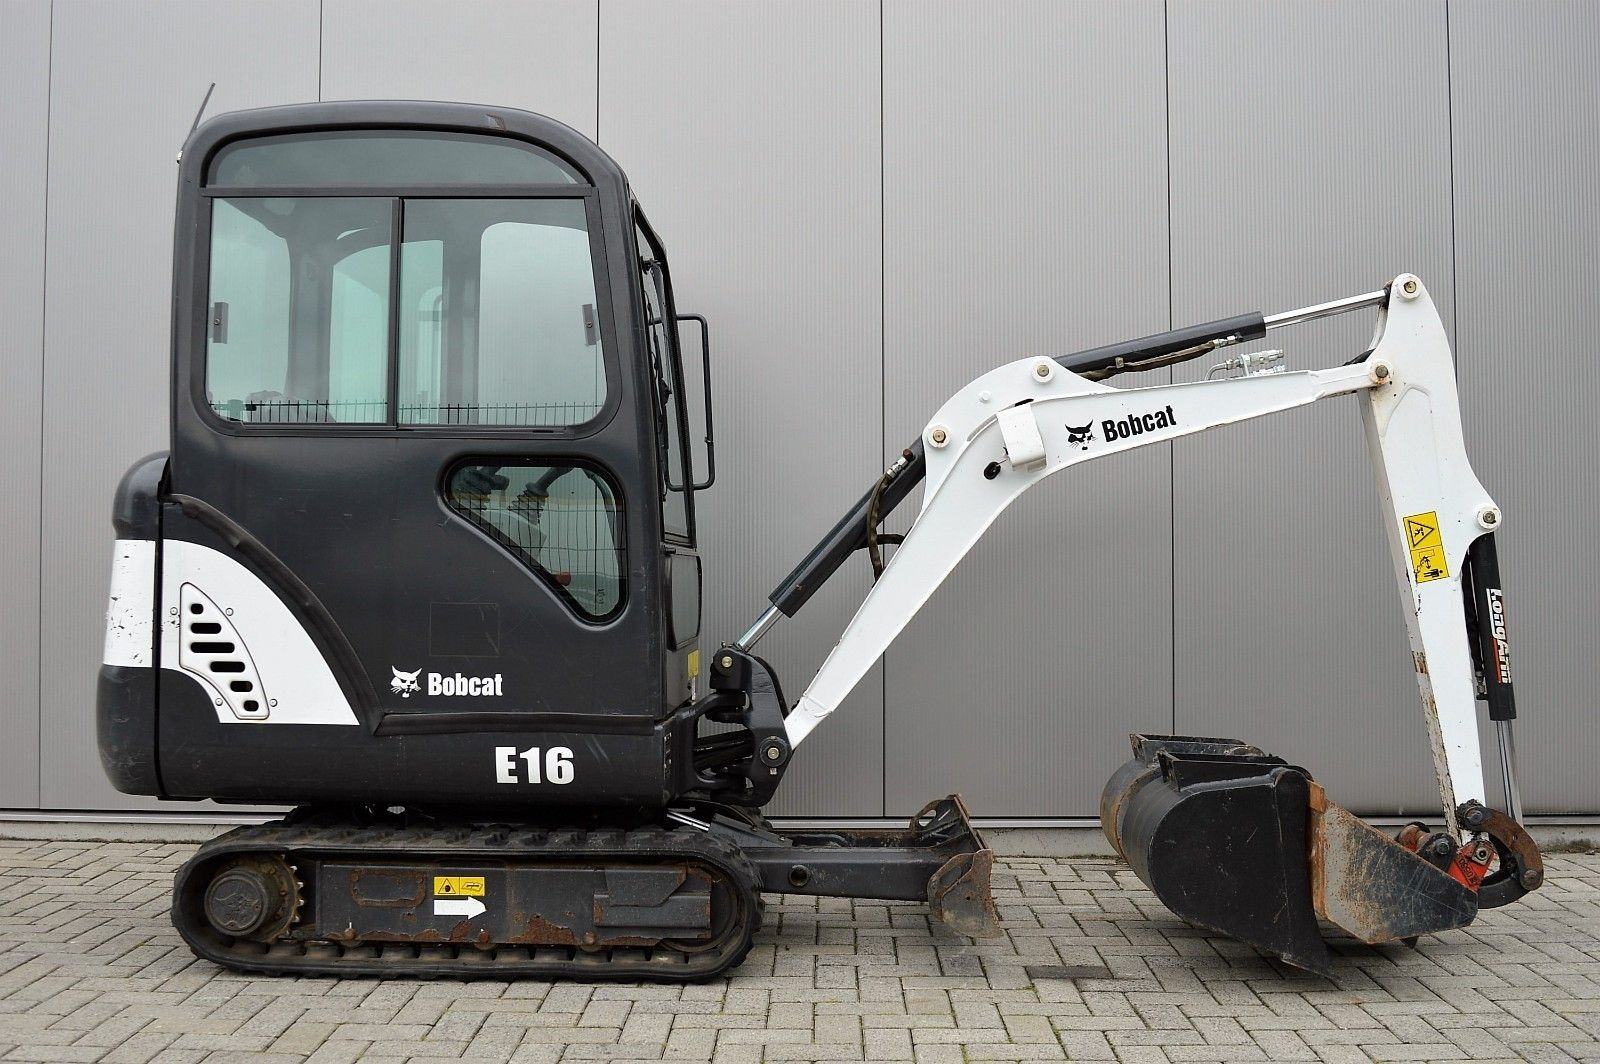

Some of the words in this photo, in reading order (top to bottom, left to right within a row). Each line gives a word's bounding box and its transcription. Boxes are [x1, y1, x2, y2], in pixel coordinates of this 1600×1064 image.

[1101, 404, 1177, 443] Bobcat
[1486, 588, 1512, 684] LongArm
[427, 672, 503, 697] Bobcat
[495, 746, 575, 785] E16
